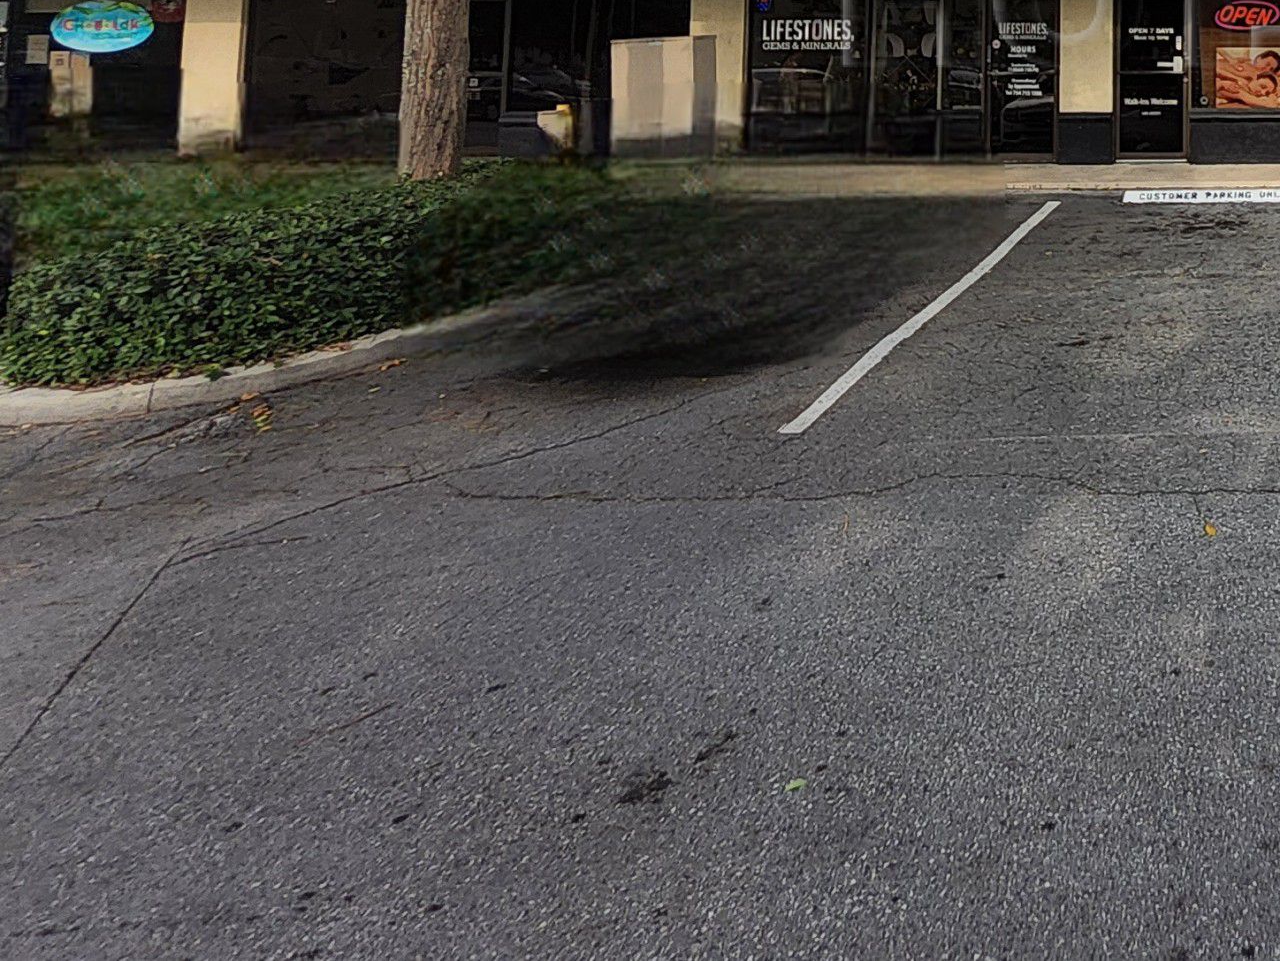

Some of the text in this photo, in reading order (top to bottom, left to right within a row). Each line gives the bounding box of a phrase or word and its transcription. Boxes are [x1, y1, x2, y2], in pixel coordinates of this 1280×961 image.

[1219, 5, 1273, 25] OPEN
[762, 41, 791, 51] GEMS
[801, 41, 851, 50] MINERALS
[1010, 45, 1036, 53] HOURS
[1139, 192, 1198, 200] CUSTOMER
[1205, 191, 1252, 200] PARKING
